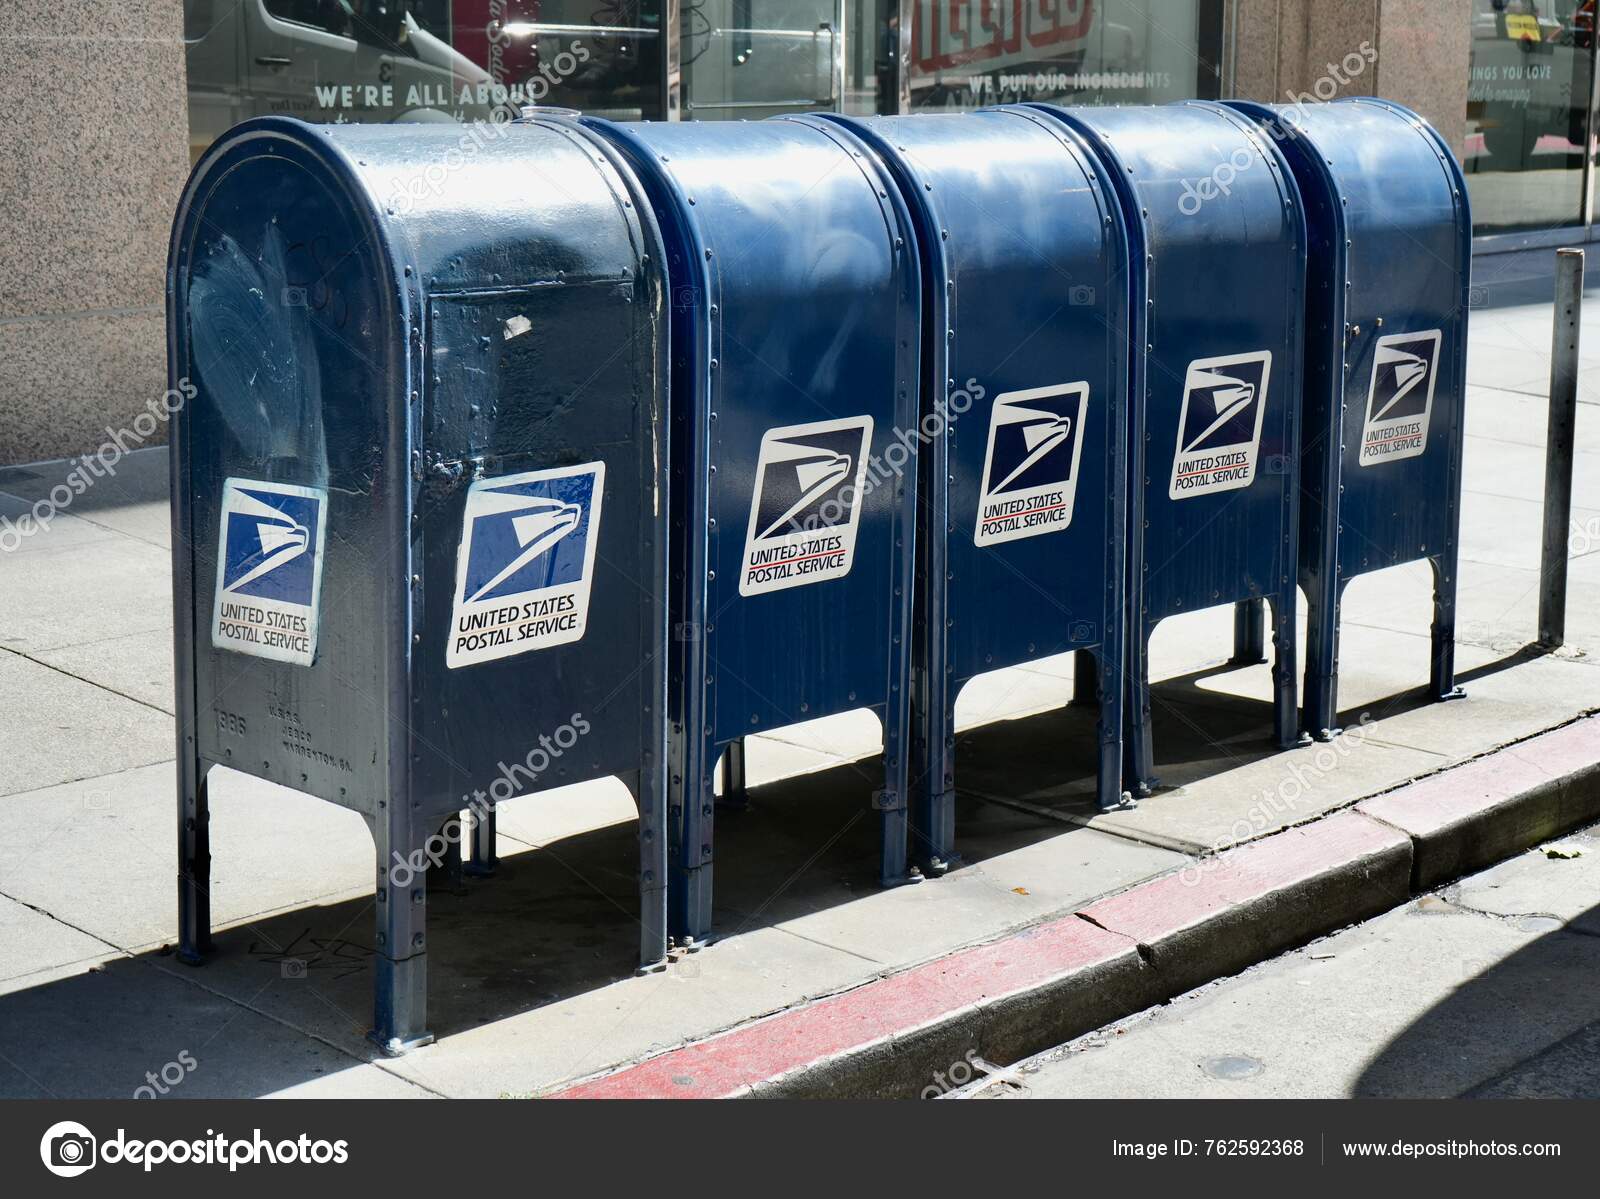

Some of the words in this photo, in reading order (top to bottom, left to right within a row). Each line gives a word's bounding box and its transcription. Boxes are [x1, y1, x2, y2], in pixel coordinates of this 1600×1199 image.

[969, 76, 992, 93] WE
[1000, 75, 1028, 91] PUT
[1035, 73, 1067, 90] OUR
[1502, 66, 1522, 80] YOU
[1526, 65, 1552, 79] LOVE
[315, 85, 393, 108] WE'RE
[405, 84, 448, 106] ALL
[459, 82, 536, 105] ABOUT
[1366, 427, 1394, 442] UNITED
[1395, 422, 1420, 437] STATES
[1364, 442, 1391, 457] POSTAL
[1392, 437, 1422, 451] SERVICE
[1177, 457, 1213, 474] UNITED
[1215, 452, 1247, 468] STATES
[1175, 474, 1210, 490] POSTAL
[1212, 466, 1249, 484] SERVICE
[984, 499, 1024, 519] UNITED
[1026, 491, 1063, 510] STATES
[981, 518, 1021, 536] POSTAL
[1023, 508, 1066, 528] SERVICE
[751, 544, 797, 565] UNITED
[799, 536, 841, 556] STATES
[747, 564, 793, 585] POSTAL
[796, 553, 845, 575] SERVICE
[221, 602, 264, 623] UNITED
[266, 611, 306, 632] STATES
[460, 606, 519, 632] UNITED
[522, 594, 575, 619] STATES
[219, 622, 260, 643] POSTAL
[263, 631, 309, 653] SERVICE
[456, 628, 513, 654] POSTAL
[517, 613, 577, 640] SERVICE
